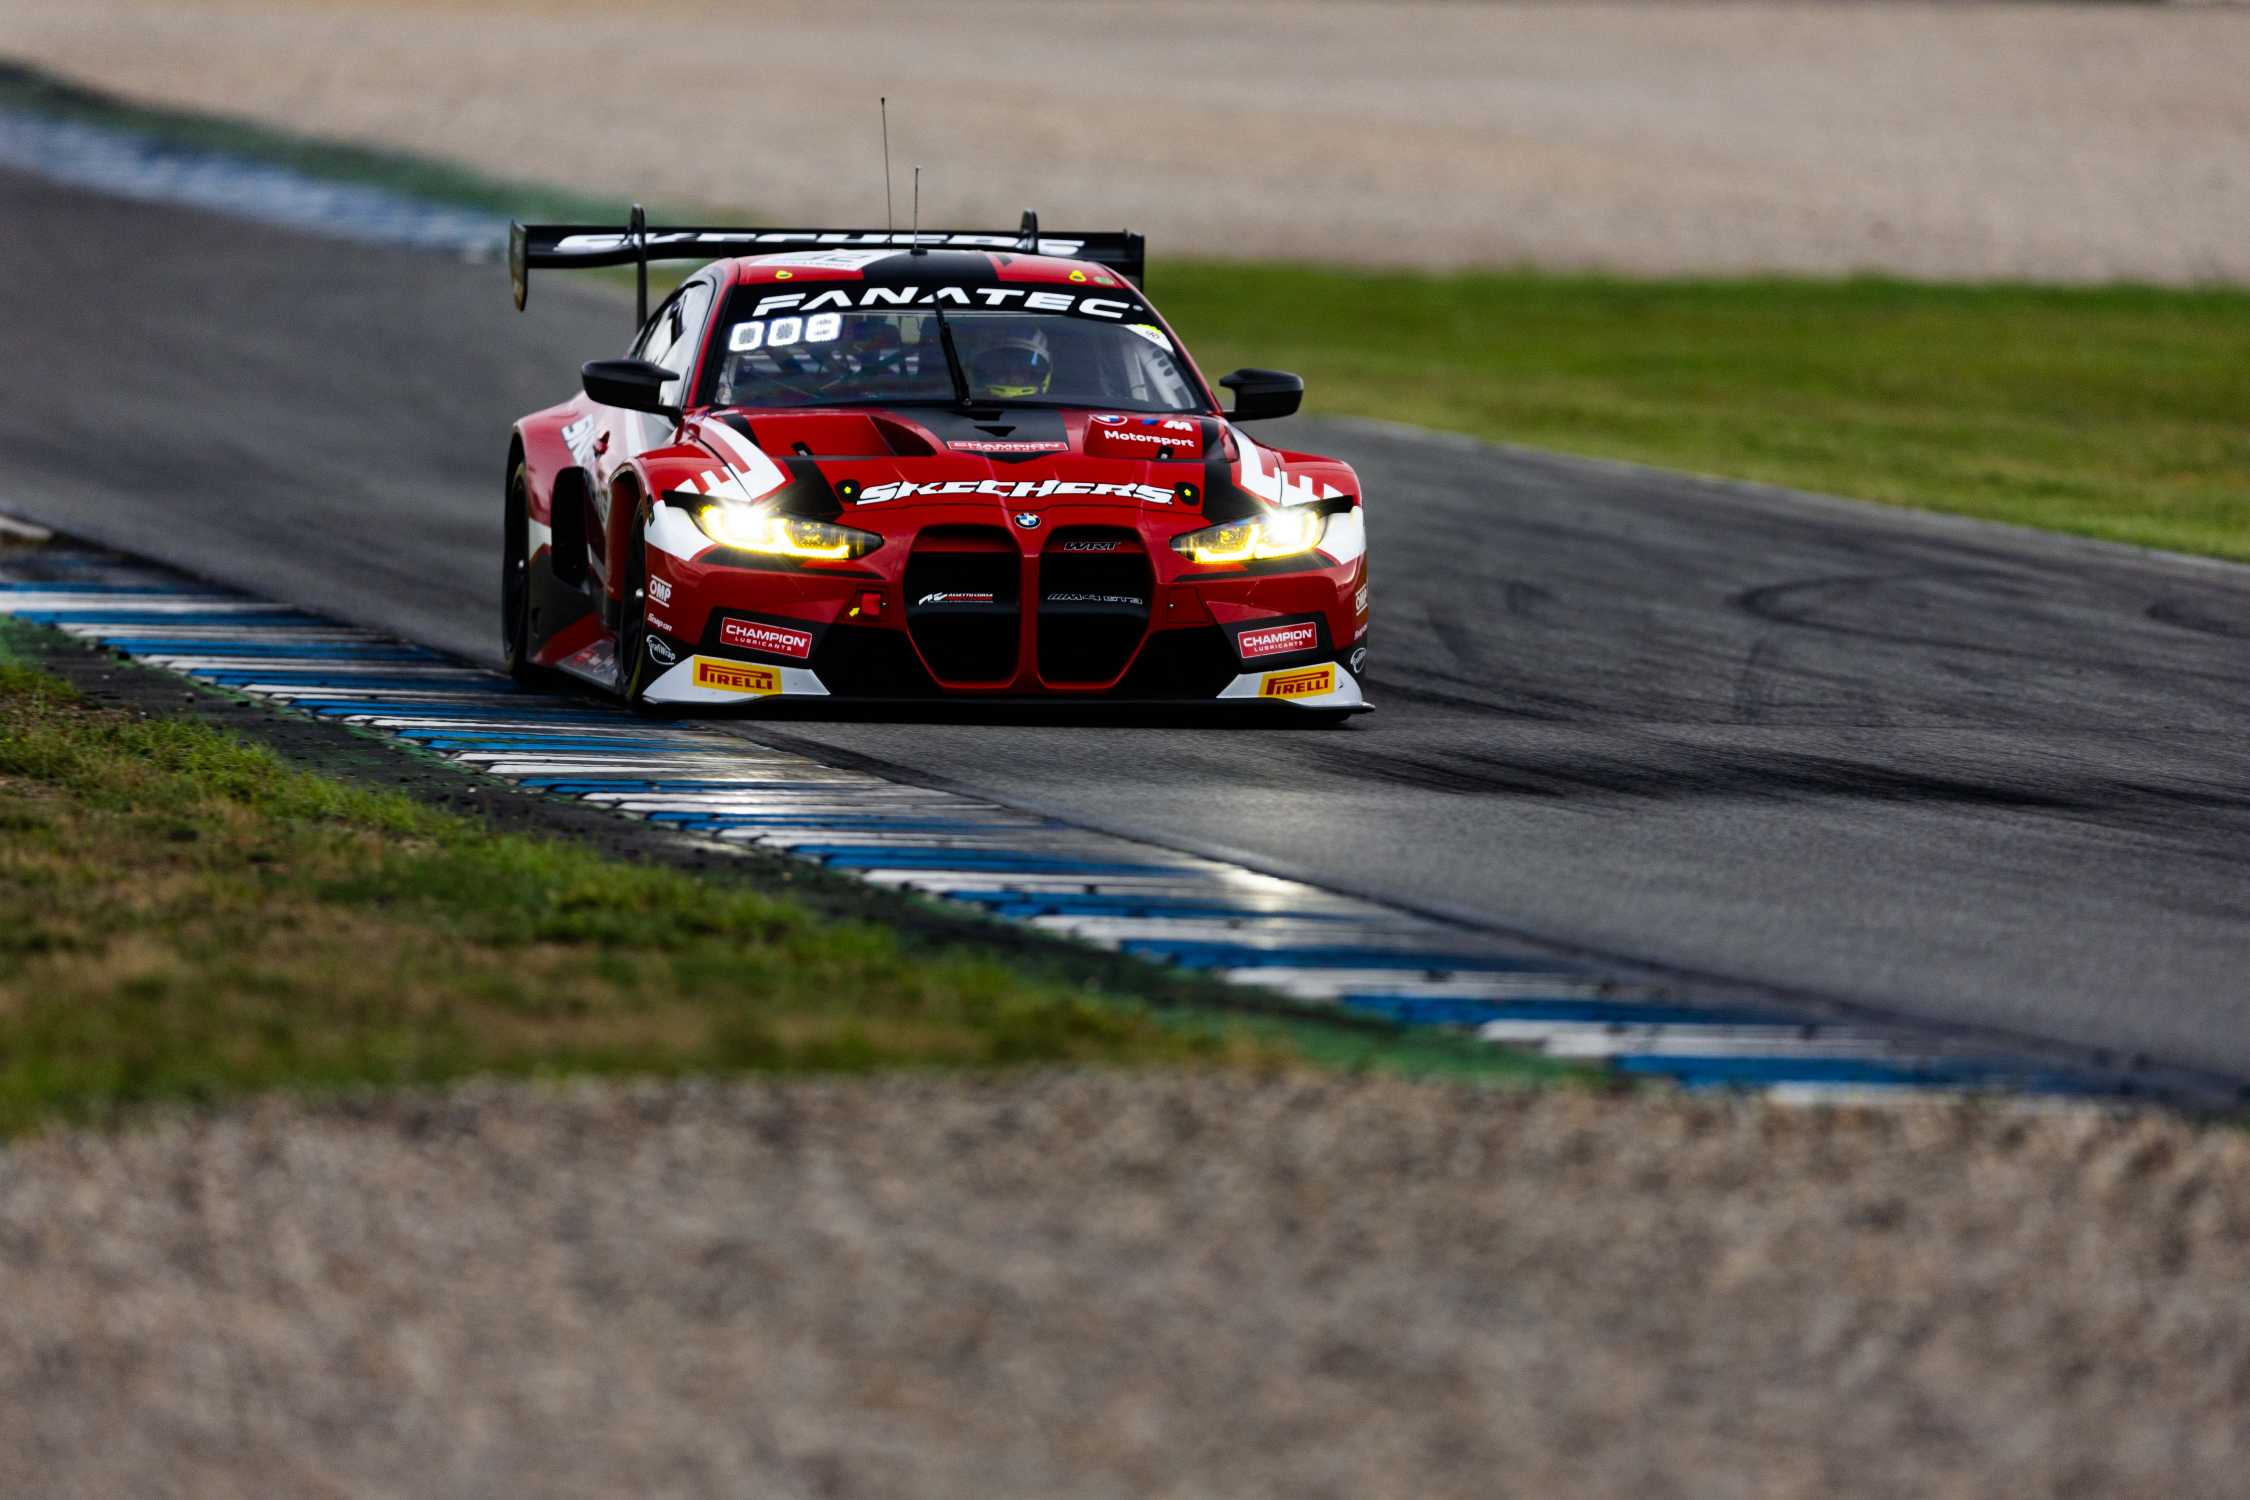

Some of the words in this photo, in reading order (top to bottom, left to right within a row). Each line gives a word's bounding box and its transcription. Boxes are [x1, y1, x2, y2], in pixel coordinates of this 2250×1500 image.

[752, 286, 1130, 318] FANATEC
[730, 313, 841, 351] 008
[1104, 430, 1194, 447] Motorsport
[856, 479, 1175, 504] SKECHERS
[650, 579, 671, 601] OMP
[726, 624, 806, 647] CHAMPION
[735, 636, 792, 651] LUBRICANTS
[1243, 629, 1312, 647] CHAMPION
[1253, 640, 1304, 652] LUBRICANTS
[699, 663, 773, 690] PIRELLI
[1266, 671, 1329, 695] PIRELLI
